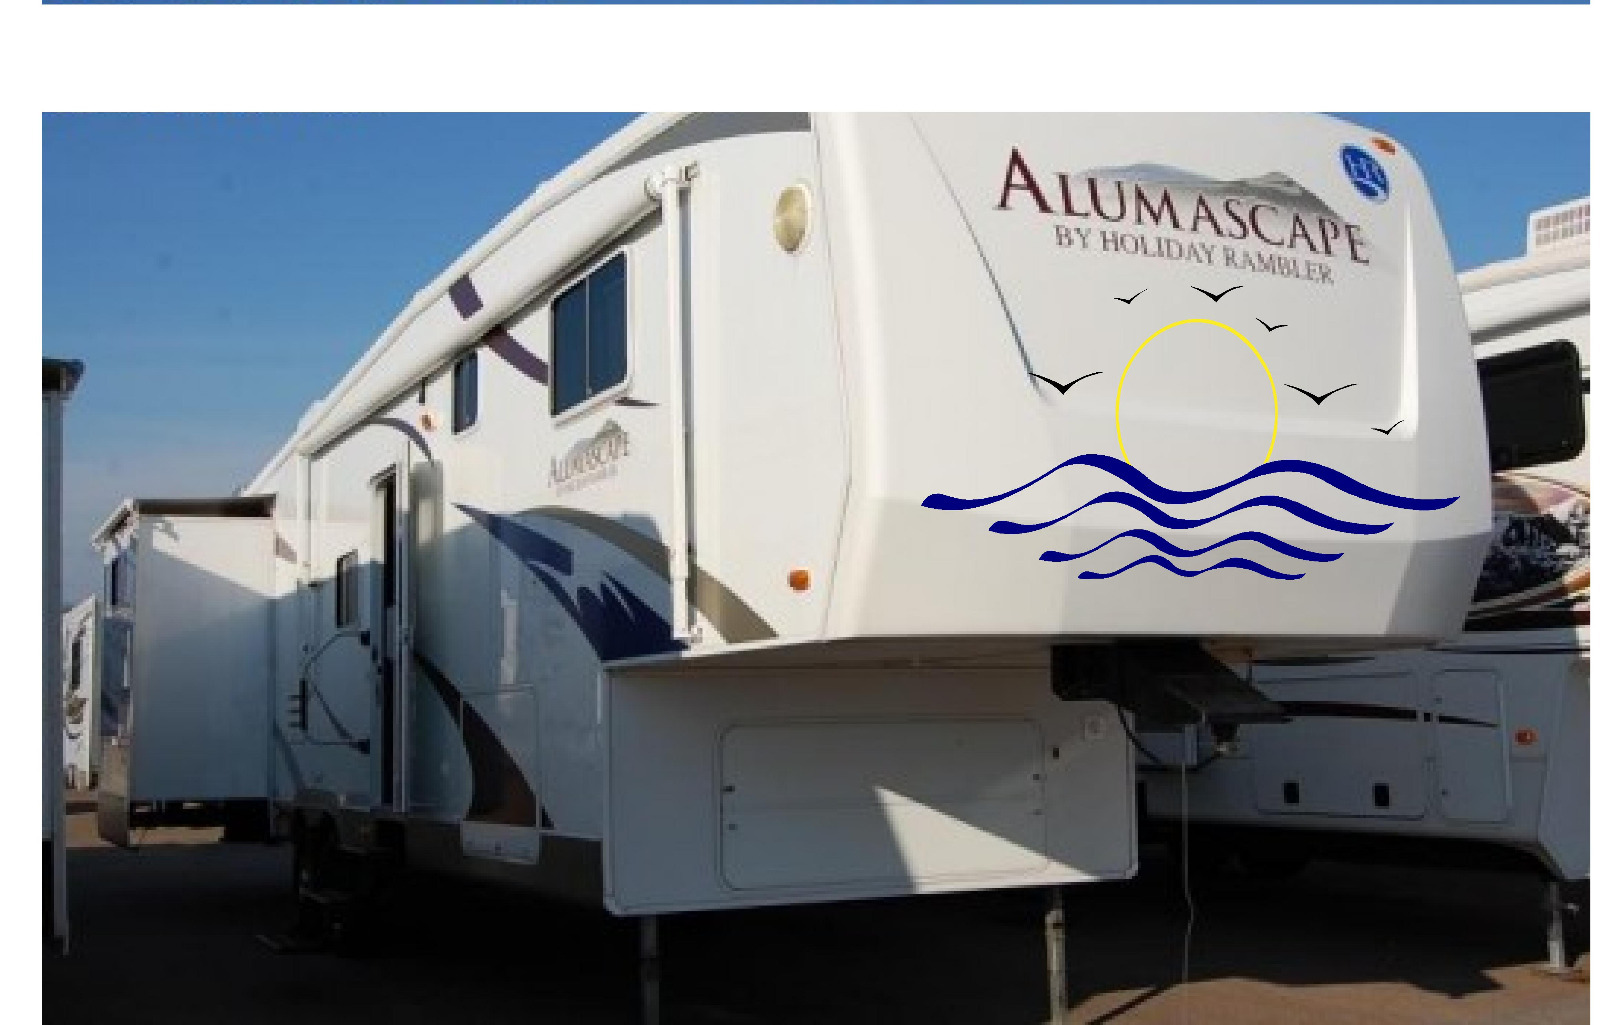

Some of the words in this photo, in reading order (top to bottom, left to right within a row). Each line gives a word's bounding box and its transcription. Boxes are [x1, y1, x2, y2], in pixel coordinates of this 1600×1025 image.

[992, 145, 1370, 265] ALUMASCAPE
[1055, 224, 1092, 249] BY
[1099, 231, 1217, 267] HOLIDAY
[1222, 247, 1335, 284] RAMBLER
